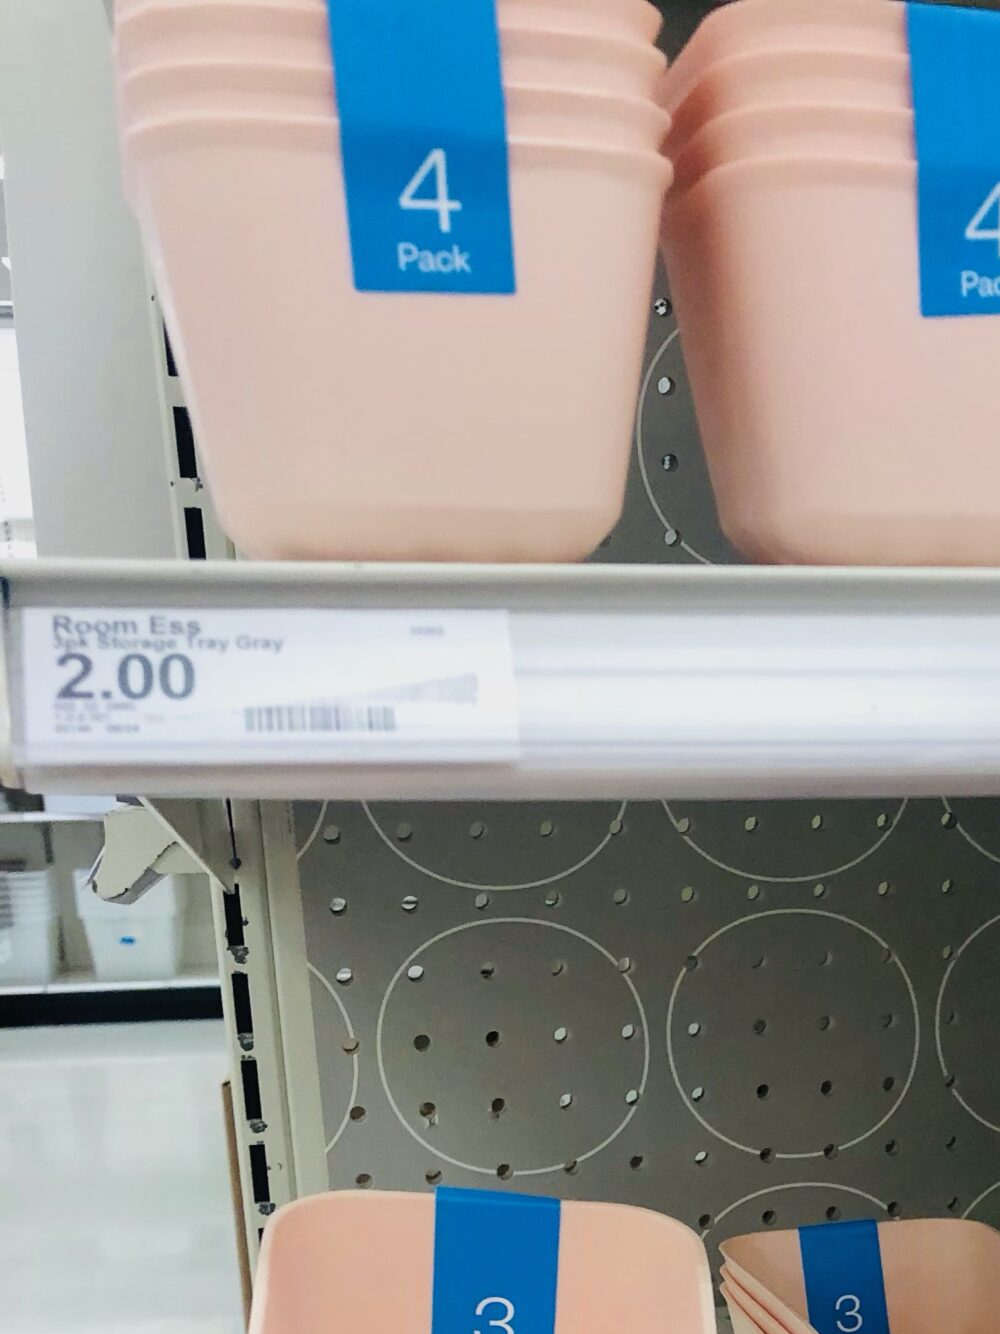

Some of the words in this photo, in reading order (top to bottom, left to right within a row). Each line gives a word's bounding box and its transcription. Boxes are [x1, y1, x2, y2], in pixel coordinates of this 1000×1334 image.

[398, 147, 462, 233] 4
[397, 241, 471, 272] Pack
[52, 615, 138, 635] Room
[149, 615, 202, 635] Ess
[99, 634, 177, 652] Storage
[186, 633, 229, 653] Tray
[235, 635, 285, 653] Gray
[56, 652, 196, 700] 2.00
[835, 1294, 862, 1333] 3
